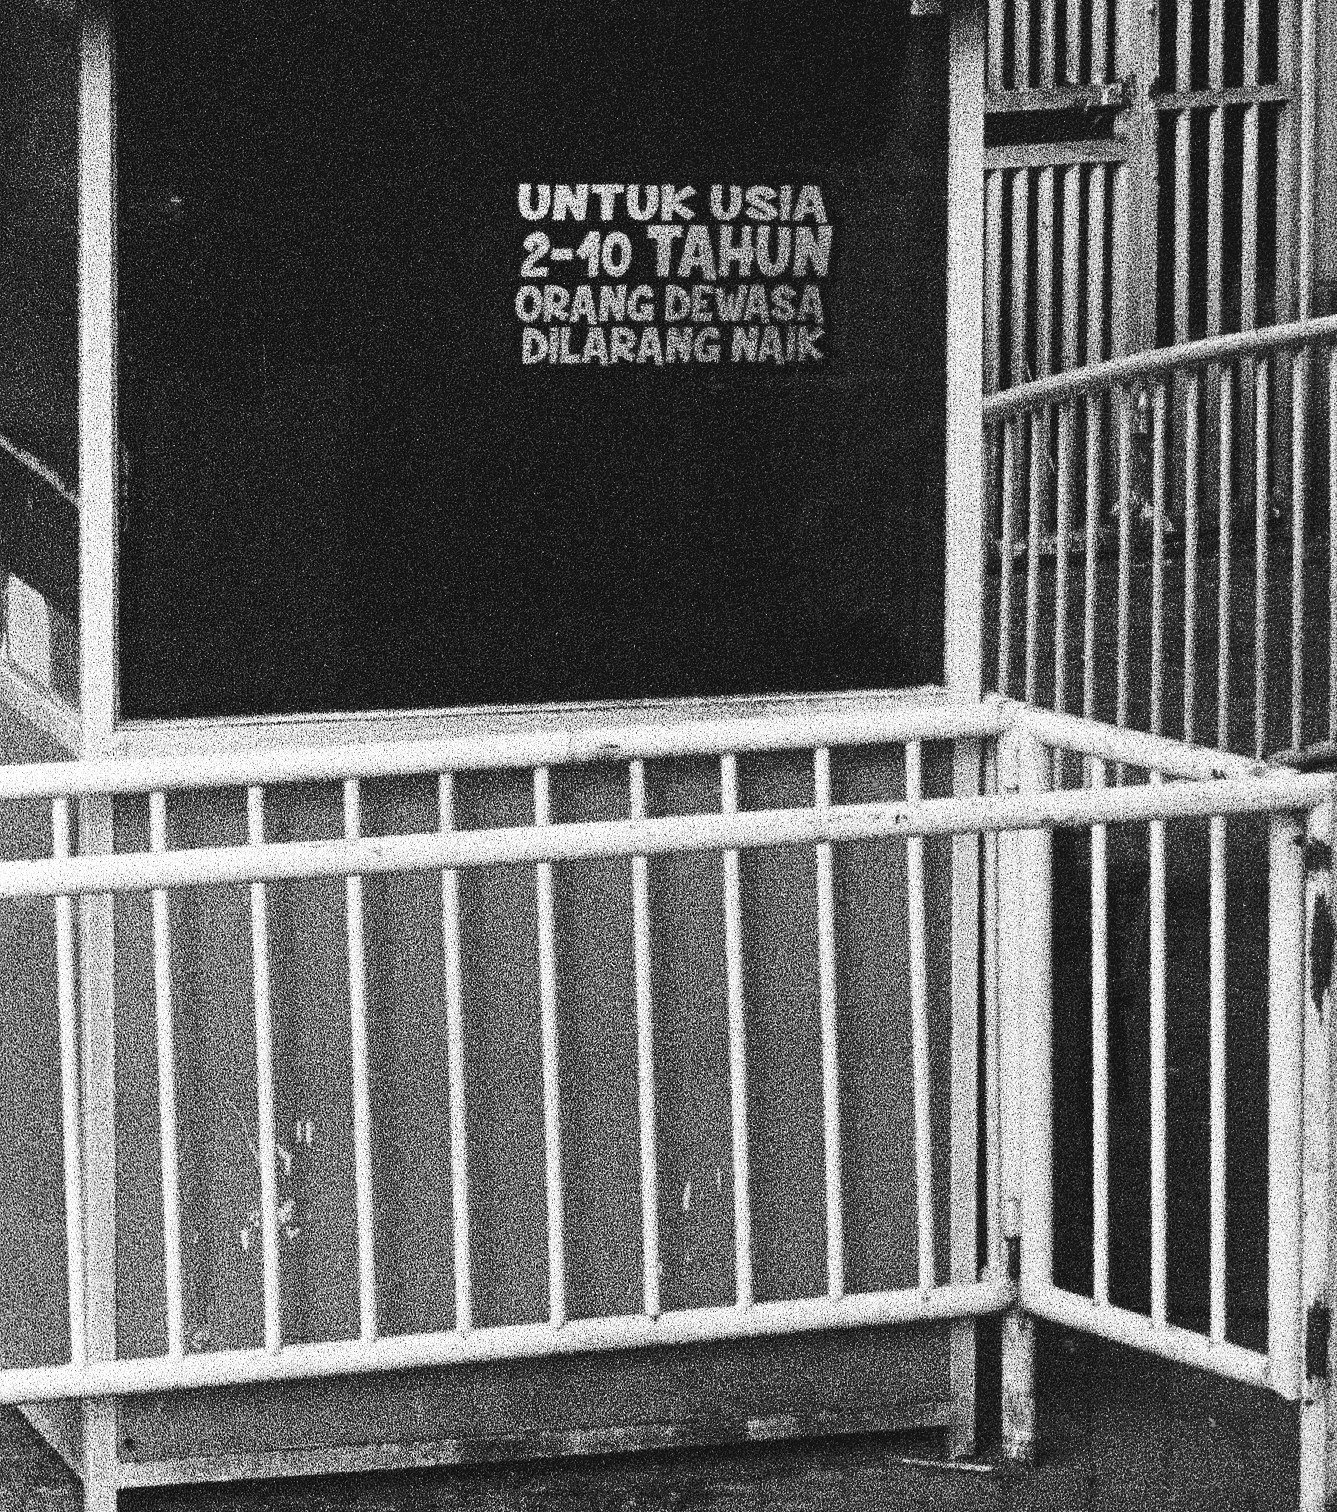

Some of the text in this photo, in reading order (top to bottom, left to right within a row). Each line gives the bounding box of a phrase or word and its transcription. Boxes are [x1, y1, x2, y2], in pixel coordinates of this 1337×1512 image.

[517, 183, 828, 223] UNTUK USIA
[520, 225, 833, 280] 2-10 TAHUN
[515, 284, 824, 325] ORANG DEWASA
[521, 326, 825, 366] DILARANG NAIK
